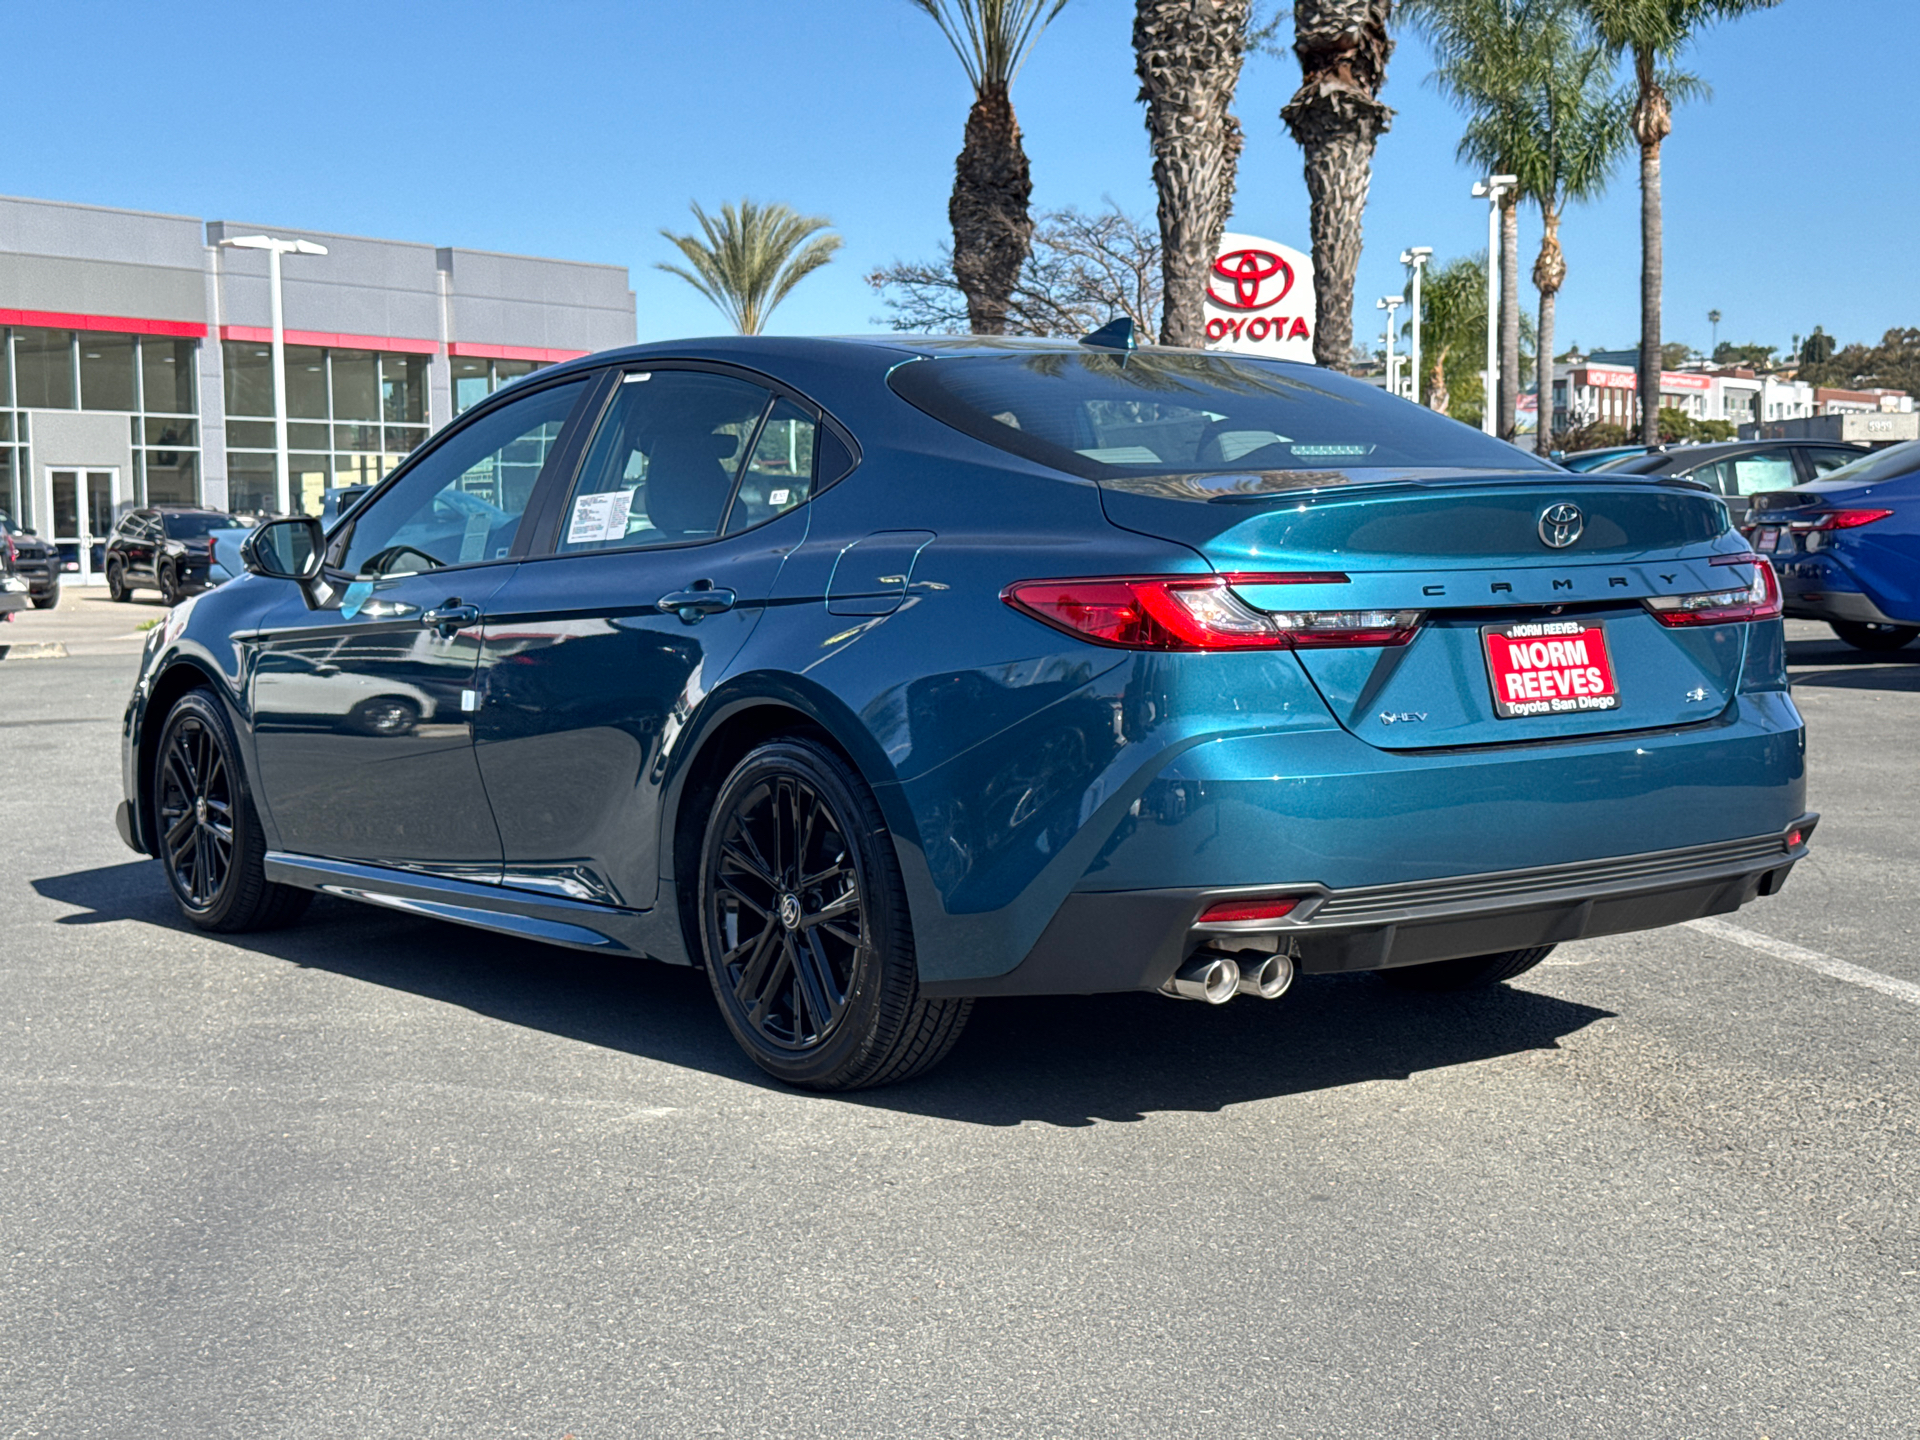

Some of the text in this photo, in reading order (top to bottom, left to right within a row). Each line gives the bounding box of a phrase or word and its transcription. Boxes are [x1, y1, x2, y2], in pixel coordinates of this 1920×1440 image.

[1205, 316, 1310, 341] OYOTA
[1589, 371, 1607, 386] NOW
[1868, 420, 1892, 431] 5959
[1422, 573, 1677, 596] CAMRY
[1512, 622, 1578, 637] NORM REEVES
[1508, 640, 1589, 670] NORM
[1505, 667, 1604, 699] REEVES
[1506, 696, 1615, 716] Toyota San Diego
